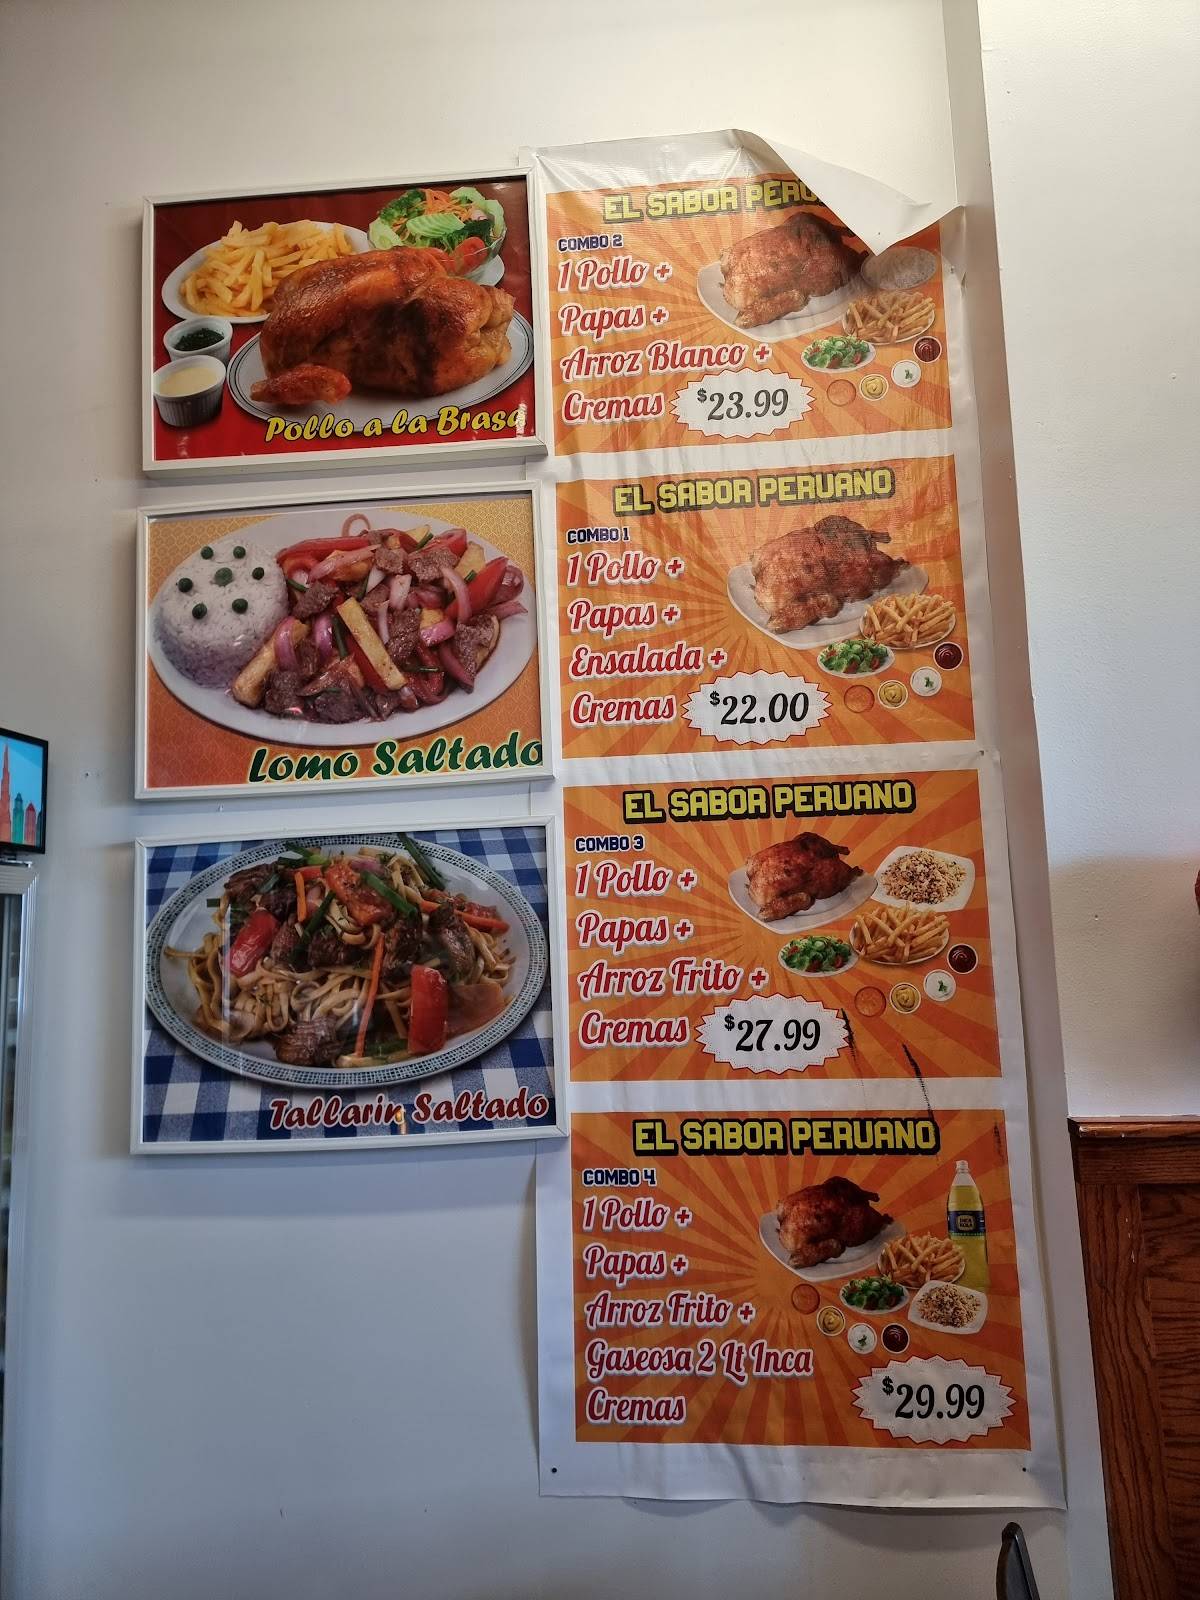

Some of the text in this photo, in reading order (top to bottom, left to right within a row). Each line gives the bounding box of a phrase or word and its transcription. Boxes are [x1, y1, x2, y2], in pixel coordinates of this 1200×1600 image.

[603, 180, 819, 222] EL SABOR PERU
[557, 235, 623, 252] COMBO 2
[558, 257, 671, 291] 1 Pollo +
[560, 305, 667, 340] Papas +
[562, 342, 771, 381] Arroz Blanco +
[564, 392, 664, 422] Cremas
[697, 388, 789, 421] $23.99
[265, 413, 353, 442] Pollo
[363, 418, 382, 437] a
[391, 409, 427, 434] la
[614, 468, 894, 514] EL SABOR PERUANO
[567, 527, 630, 543] COMBO 1
[568, 552, 683, 584] 1 Pollo +
[569, 600, 680, 636] Papas +
[570, 645, 726, 678] Ensalada +
[571, 693, 675, 725] Cremas
[709, 691, 810, 726] $22.00
[249, 731, 543, 782] Lomo Saltado
[624, 781, 914, 822] EL SABOR PERUANO
[575, 836, 644, 852] COMBO 3
[576, 860, 696, 894] 1 Pollo +
[578, 913, 692, 953] Papas +
[579, 959, 768, 998] Arroz Frito +
[581, 1011, 688, 1045] Cremas
[724, 1014, 821, 1052] $27.99
[271, 1087, 548, 1128] Tallarin Saltado
[634, 1120, 938, 1153] EL SABOR PERUANO
[583, 1169, 656, 1186] COMBO 4
[583, 1197, 692, 1229] 1 Pollo +
[585, 1245, 688, 1284] Papas +
[586, 1292, 755, 1328] Arroz Frito +
[586, 1340, 813, 1383] Gaseosa 2 Lt Inca
[586, 1389, 685, 1423] Cremas
[881, 1376, 986, 1419] $29.99
